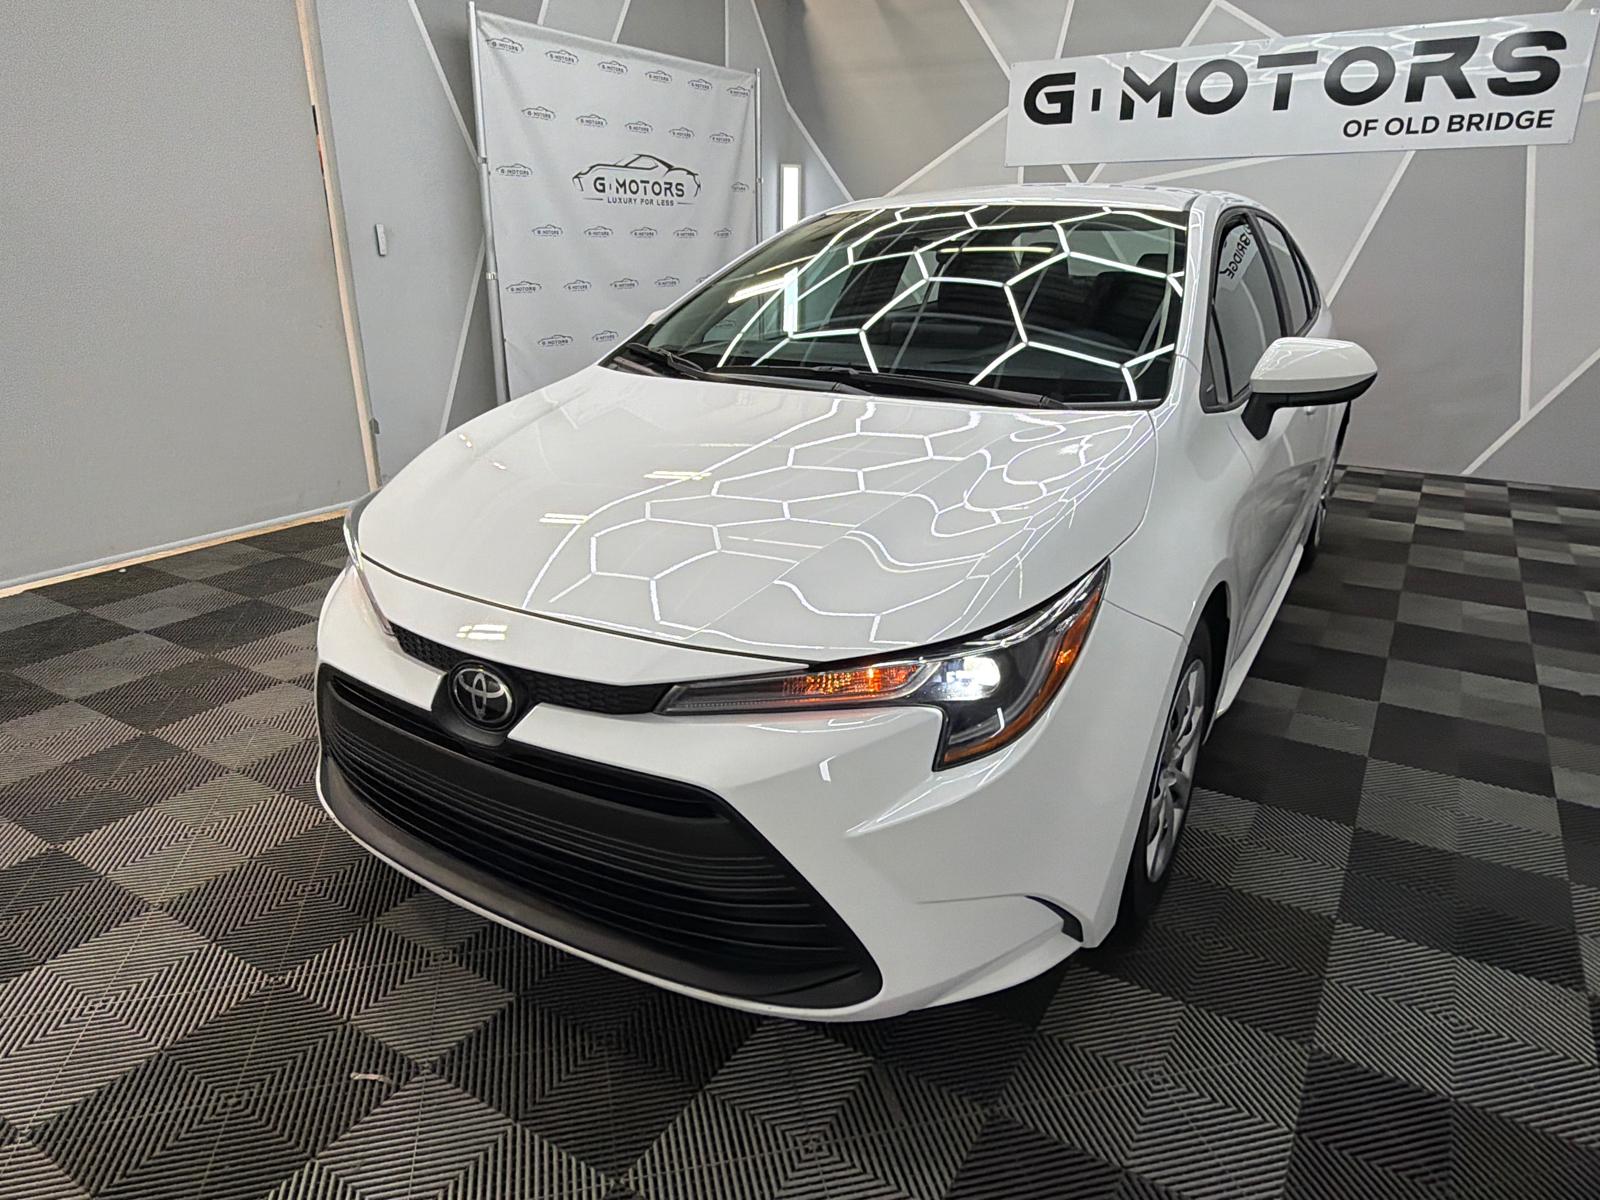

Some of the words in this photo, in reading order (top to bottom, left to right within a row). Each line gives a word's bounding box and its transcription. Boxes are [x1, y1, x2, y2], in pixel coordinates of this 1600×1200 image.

[1119, 30, 1568, 121] MOTORS
[1342, 118, 1378, 138] OF
[1384, 114, 1440, 137] OLD
[1446, 109, 1556, 133] BRIDGE
[616, 178, 684, 198] MOTORS
